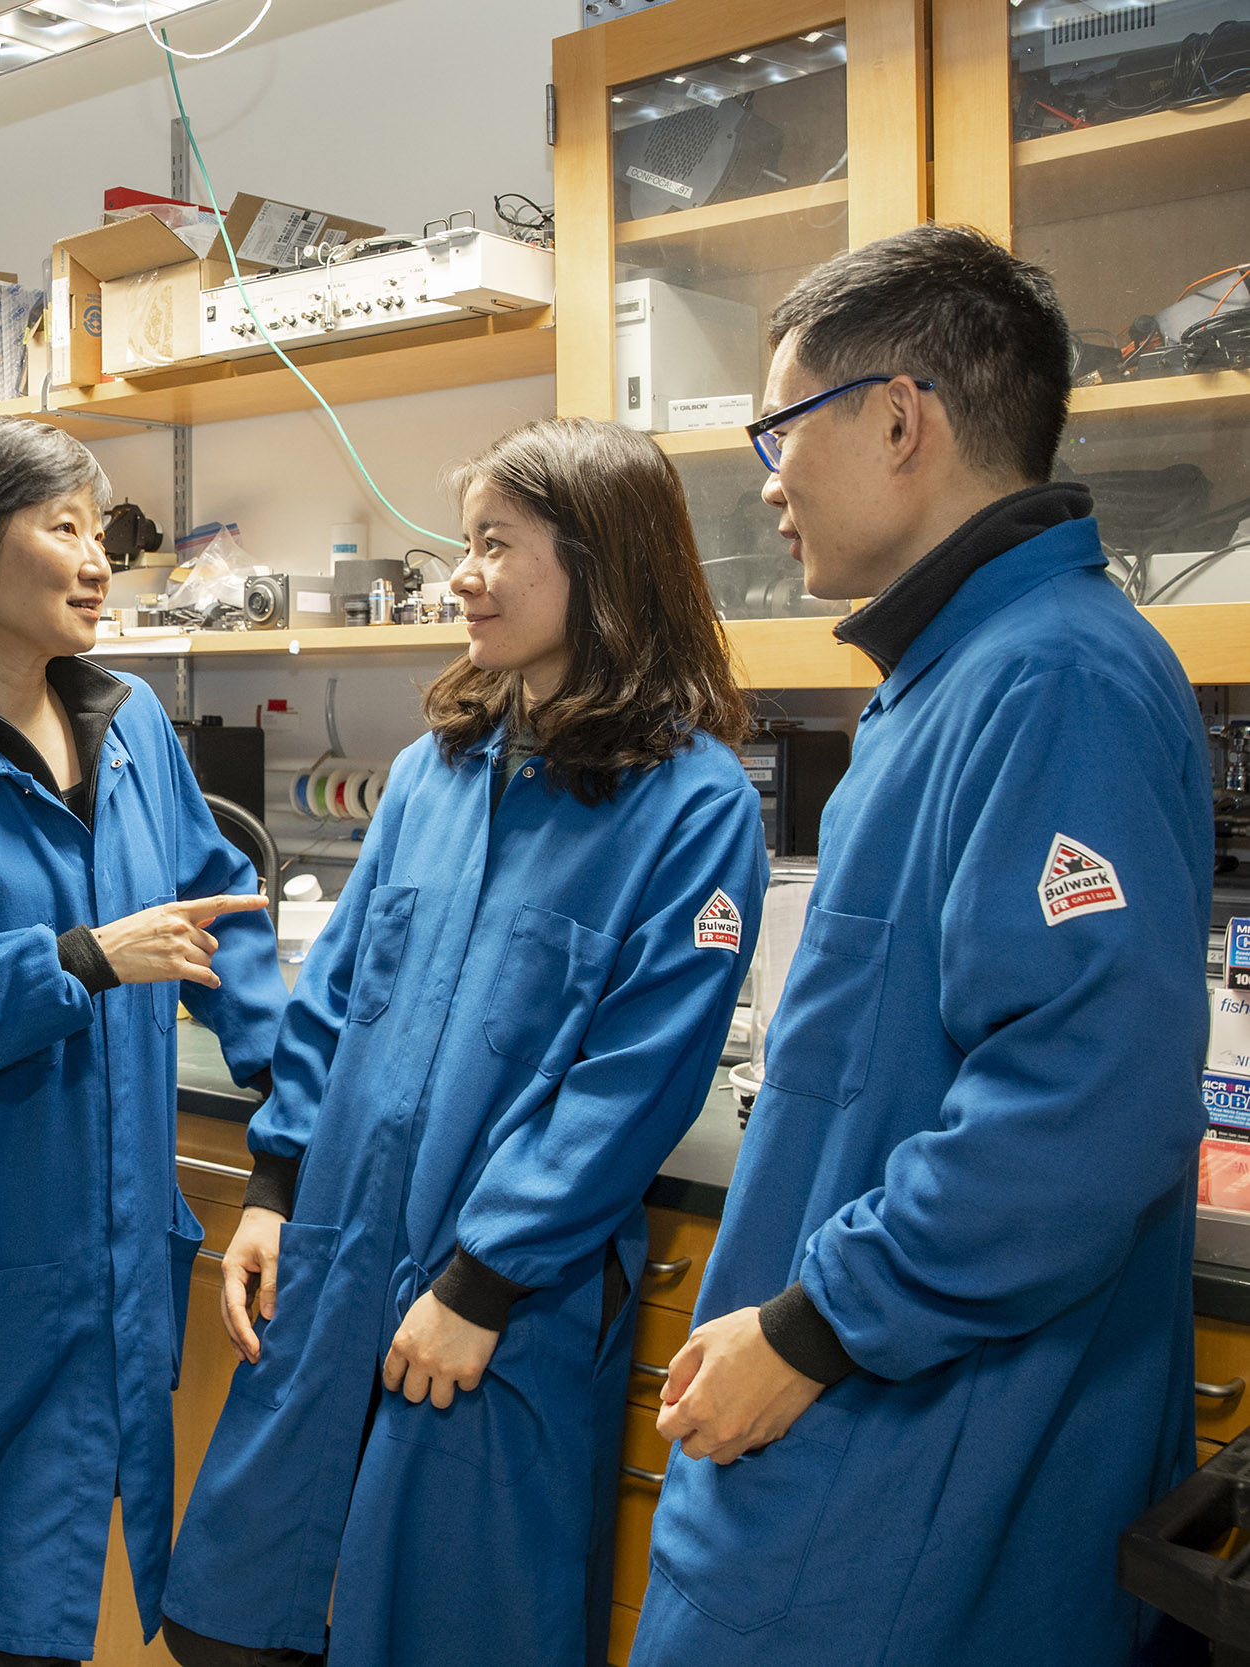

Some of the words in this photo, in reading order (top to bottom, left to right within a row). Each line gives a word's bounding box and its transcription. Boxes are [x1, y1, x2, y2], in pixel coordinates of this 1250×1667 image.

[630, 168, 673, 190] CONFOCAL
[680, 403, 708, 411] GILSON
[1045, 872, 1111, 902] Bulwark
[1052, 899, 1070, 914] FR
[1070, 893, 1086, 904] CAT
[702, 933, 714, 942] FR
[1221, 998, 1250, 1015] fish
